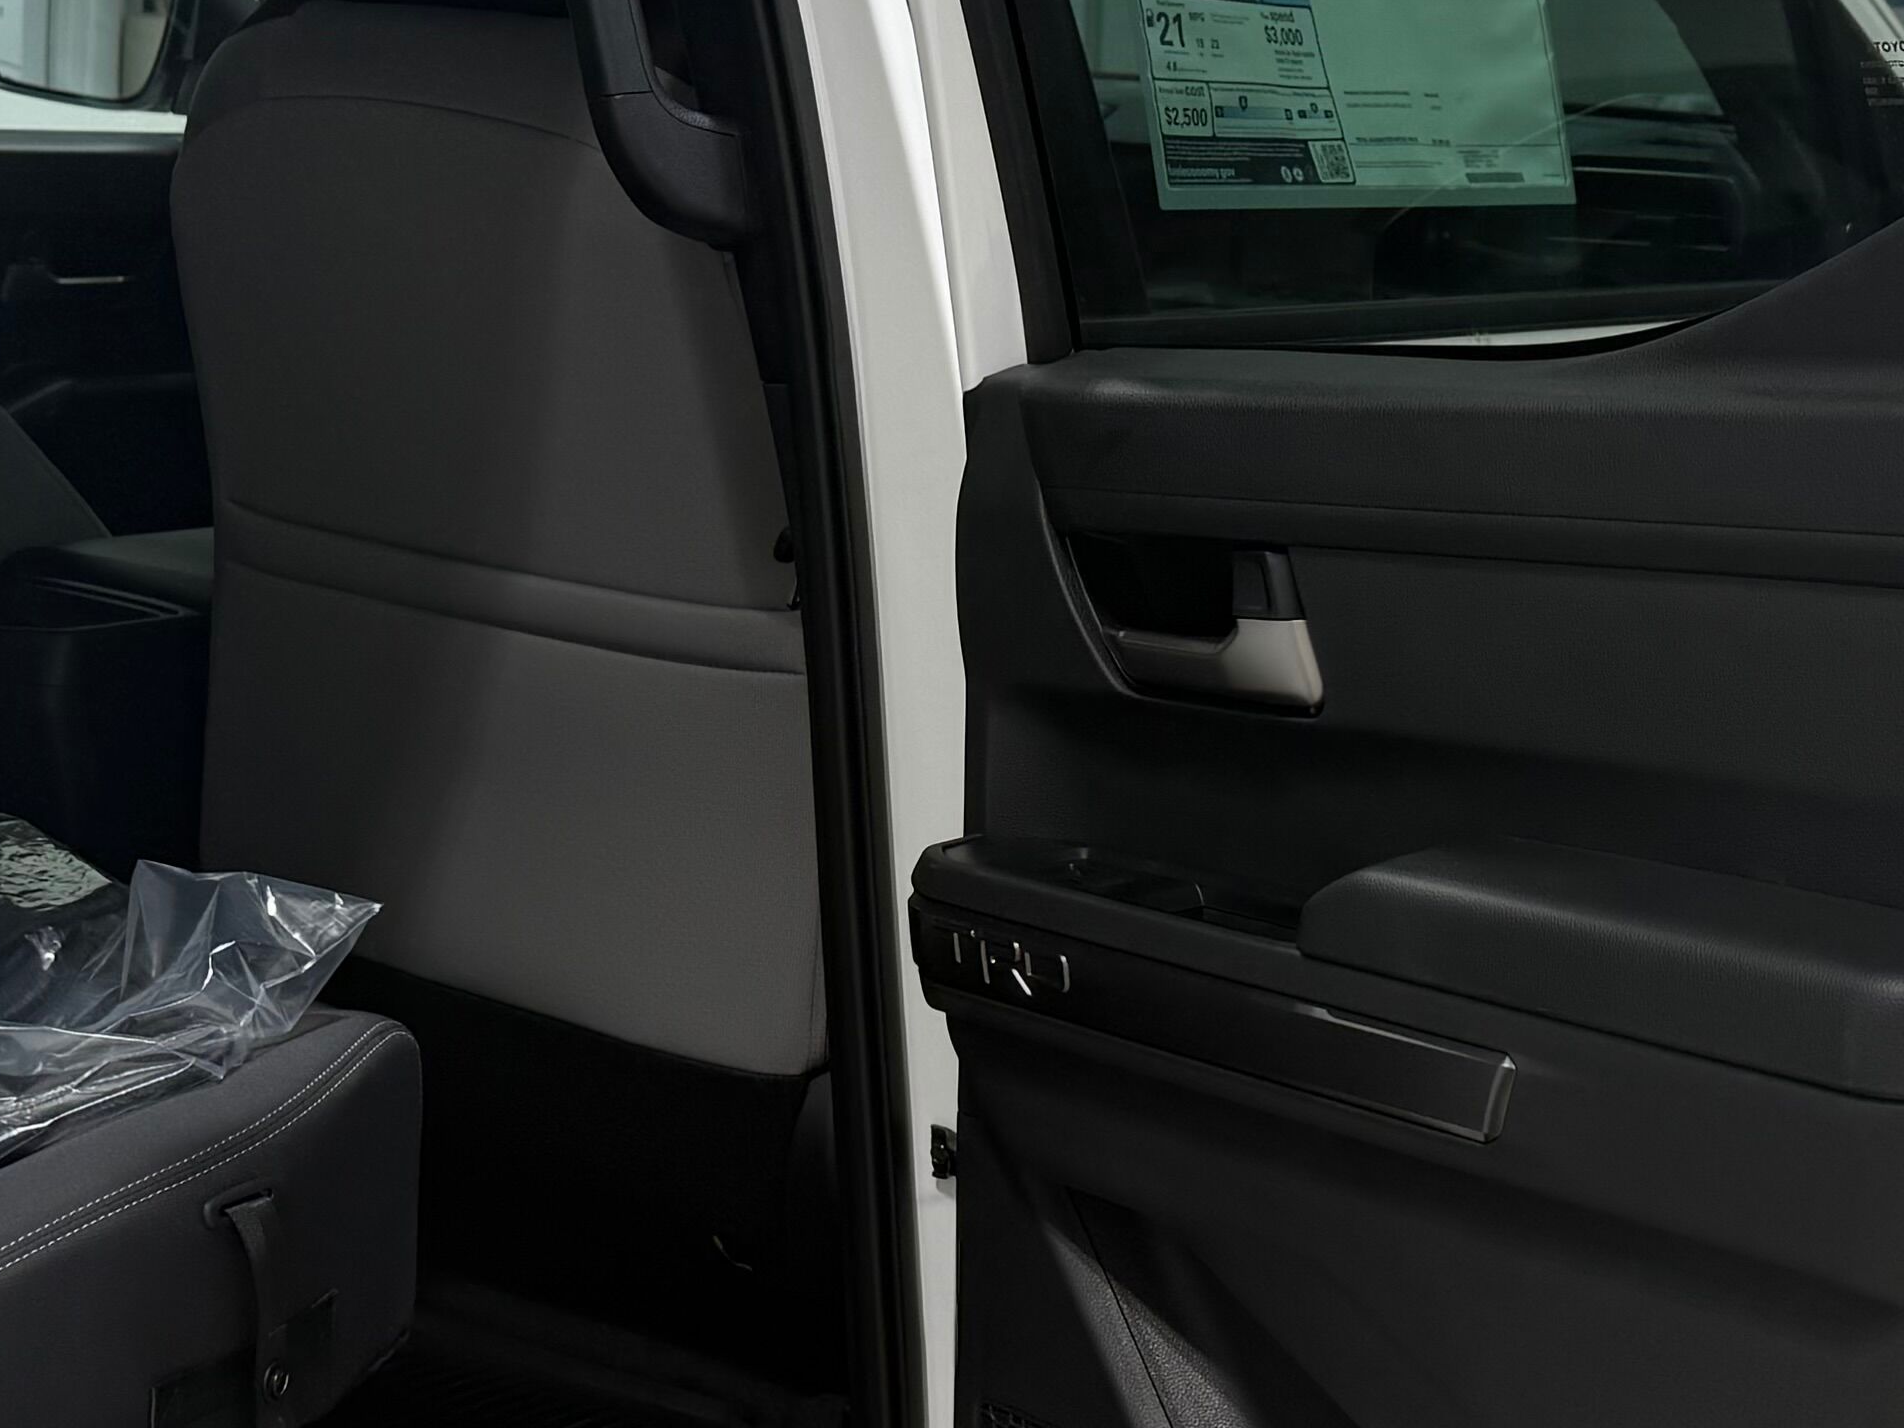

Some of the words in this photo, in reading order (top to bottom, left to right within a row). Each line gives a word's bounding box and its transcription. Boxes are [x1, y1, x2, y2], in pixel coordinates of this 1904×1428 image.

[1156, 11, 1186, 48] 21
[1264, 25, 1304, 47] $3,000
[1164, 106, 1208, 128] $2,500
